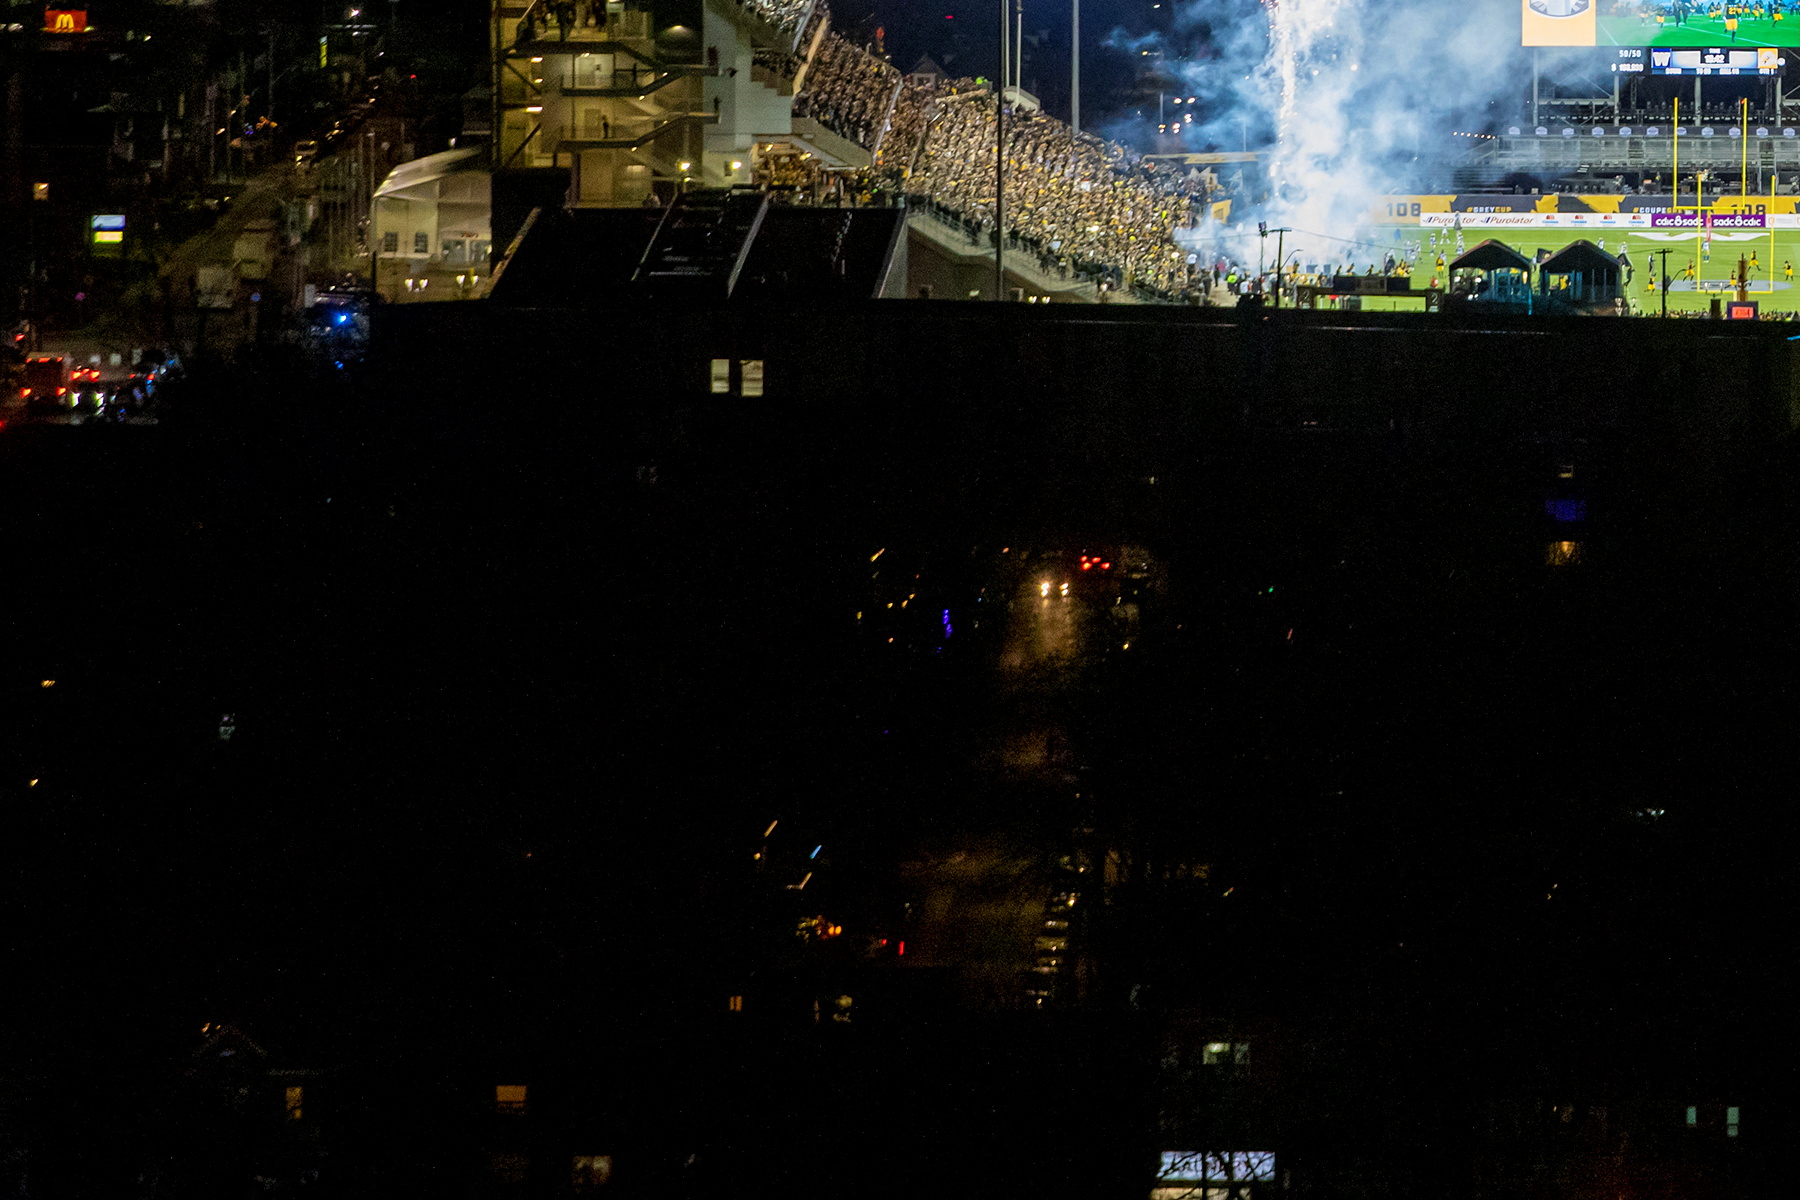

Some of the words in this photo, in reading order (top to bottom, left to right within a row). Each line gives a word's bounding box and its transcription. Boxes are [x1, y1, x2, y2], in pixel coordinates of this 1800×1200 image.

[1619, 49, 1642, 58] 50/50
[1386, 203, 1421, 217] 108
[1431, 216, 1476, 225] Purotor
[1489, 216, 1534, 225] Purolator
[1713, 217, 1734, 226] sadc
[1743, 217, 1761, 226] cdic
